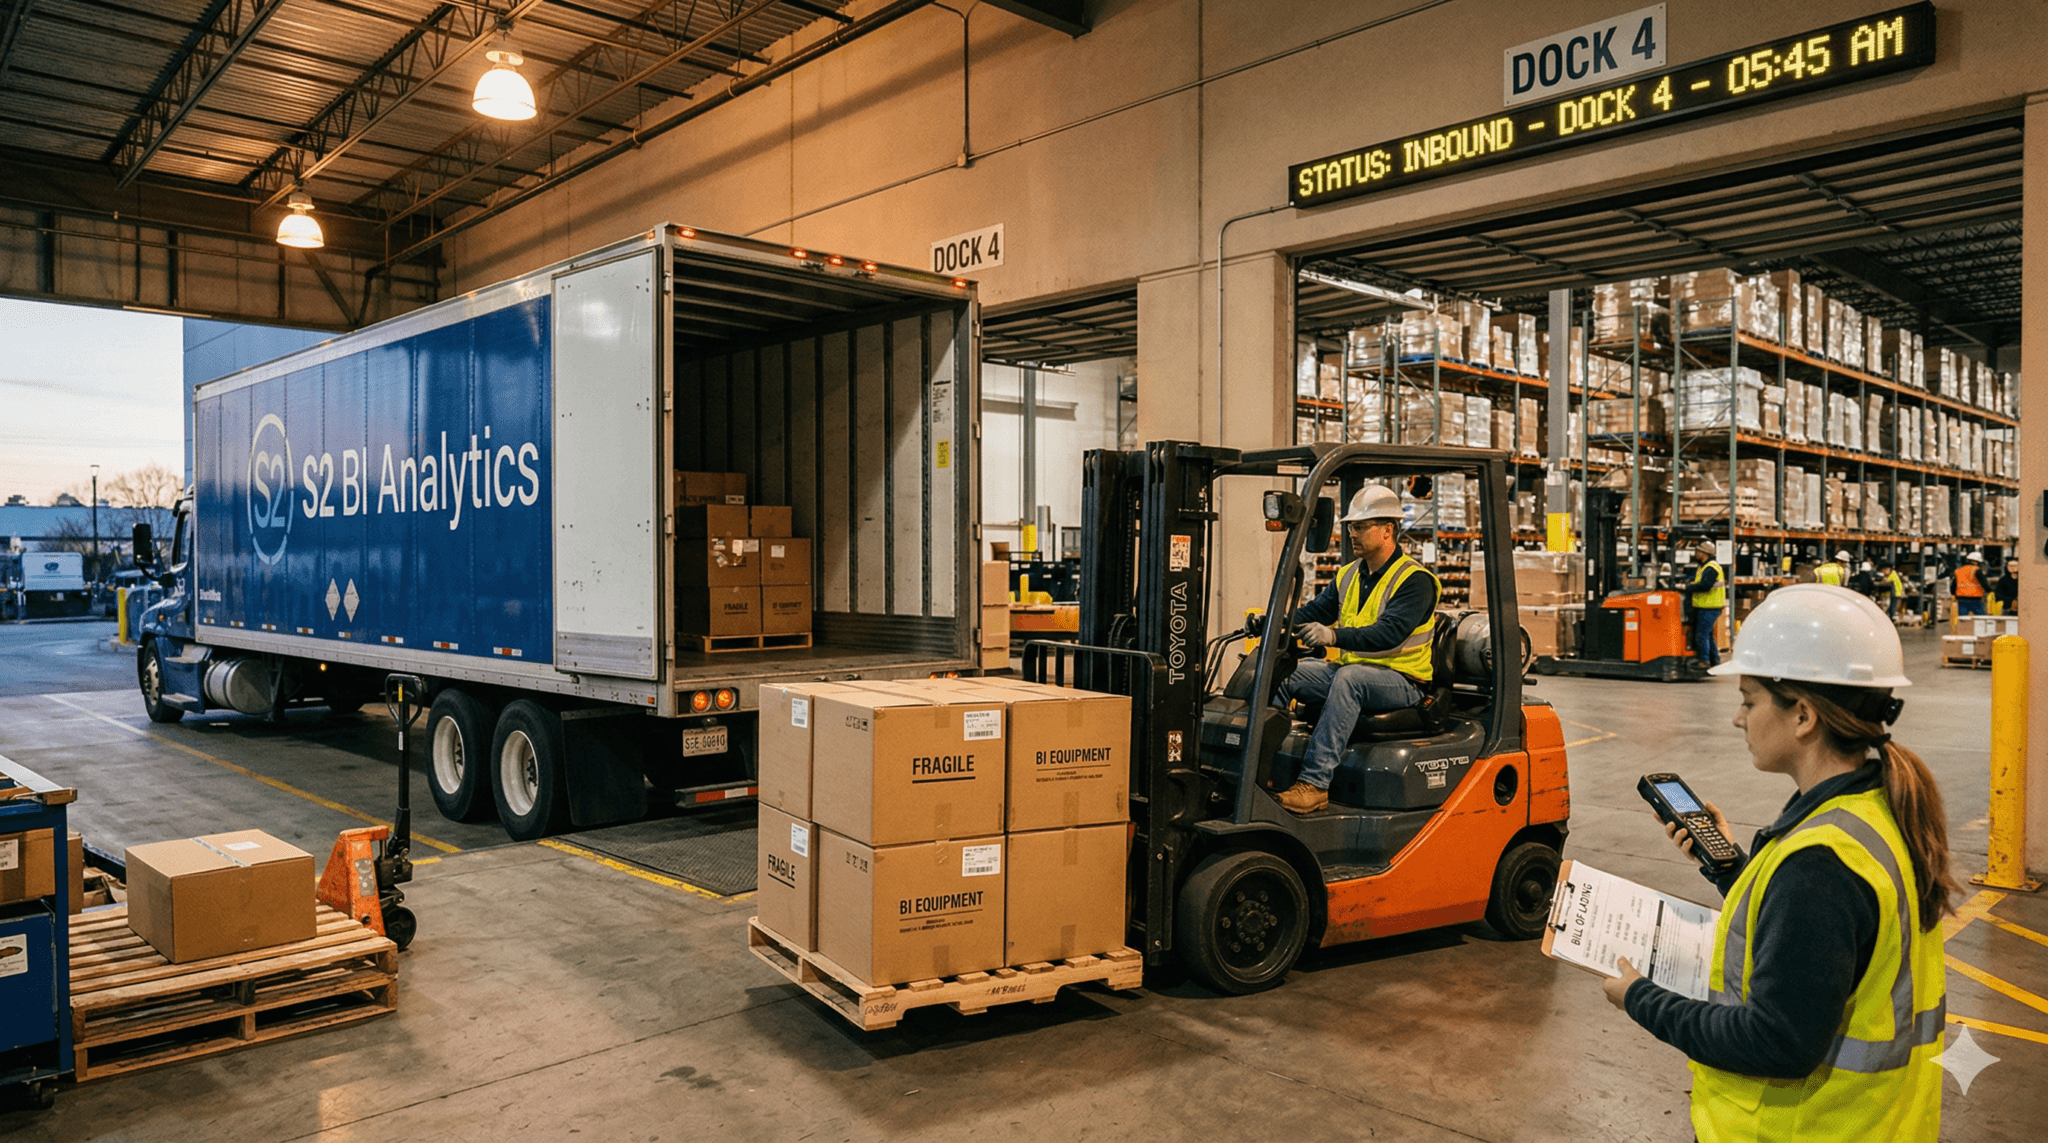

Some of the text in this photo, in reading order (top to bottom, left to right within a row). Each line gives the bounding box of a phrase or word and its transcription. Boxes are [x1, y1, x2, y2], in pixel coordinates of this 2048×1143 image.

[1513, 16, 1656, 95] DOCK 4
[1299, 149, 1392, 197] STATUS:
[1403, 117, 1514, 173] INBOUND
[1559, 84, 1636, 136] DOCK
[1653, 76, 1673, 111] 4
[1728, 34, 1831, 94] 05:45
[1851, 16, 1904, 66] AM
[934, 231, 1000, 274] DOCK 4
[254, 451, 285, 528] S2
[302, 425, 540, 531] S2 BI Analytics
[1169, 581, 1188, 685] TOYOTA
[912, 754, 975, 775] FRAGILE
[1036, 747, 1112, 765] BI EQUIPMENT
[768, 853, 796, 882] FRAGILE
[900, 891, 984, 915] BI EQUIPMENT
[1570, 882, 1593, 946] BILL OF LADING
